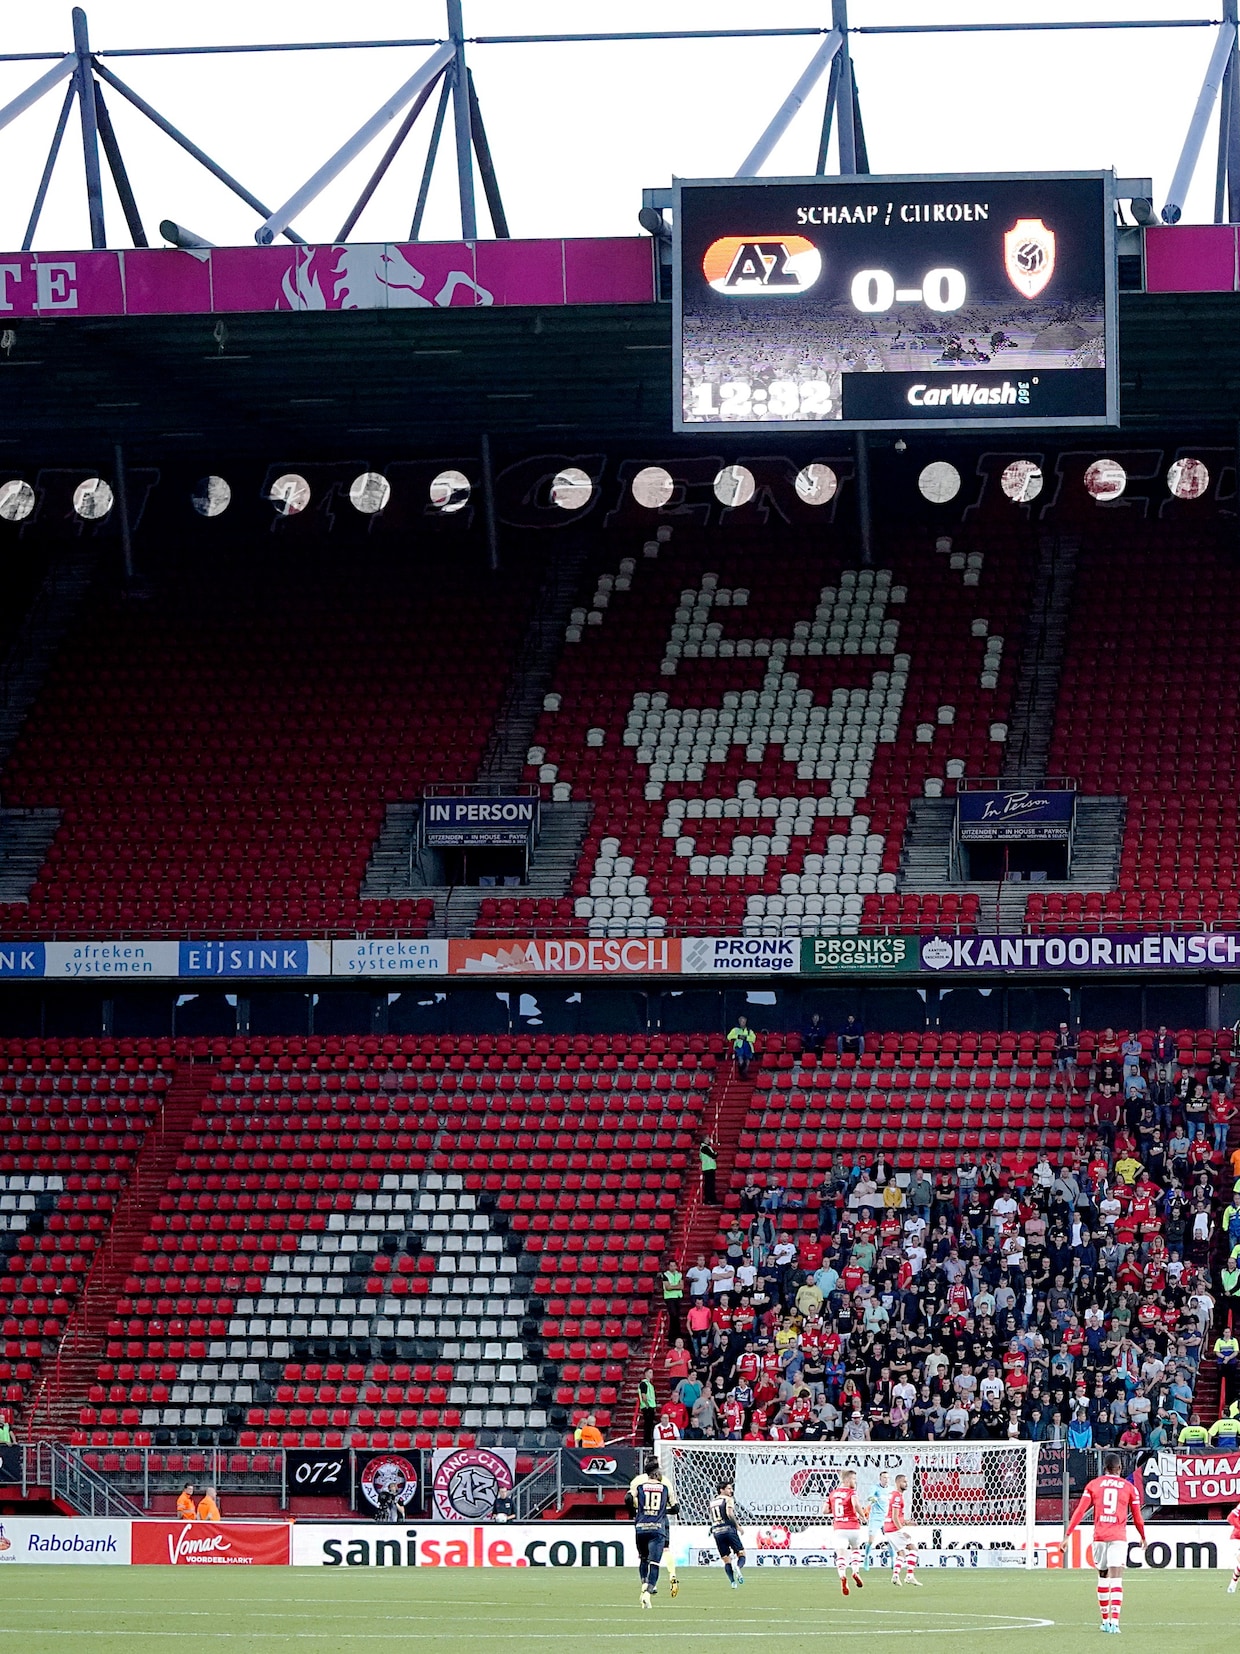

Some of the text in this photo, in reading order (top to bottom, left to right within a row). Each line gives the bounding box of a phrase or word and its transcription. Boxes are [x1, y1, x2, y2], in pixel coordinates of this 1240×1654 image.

[796, 202, 878, 225] SCHAAP
[722, 241, 802, 288] AZ
[851, 267, 967, 313] 0-0
[907, 383, 1017, 406] CarWash
[430, 803, 533, 821] IN PERSON
[981, 791, 1051, 820] In Person
[73, 944, 145, 959] afreken
[357, 941, 430, 956] afreken
[714, 939, 794, 955] PRONK
[814, 938, 906, 953] PRONK'S
[349, 956, 439, 973] systemen
[523, 940, 669, 972] ARDESCH
[713, 955, 794, 971] montage
[814, 952, 906, 965] DOGSHOP
[65, 960, 153, 976] systemen
[437, 1452, 511, 1487] PANC-CITY
[749, 1453, 903, 1469] WAARLAND
[452, 1468, 497, 1508] AZ
[1100, 1479, 1126, 1489] AFAS
[1145, 1481, 1180, 1500] ON
[643, 1491, 661, 1510] 18
[749, 1501, 820, 1515] Supporting
[834, 1497, 845, 1518] 6
[1103, 1487, 1118, 1515] 9
[28, 1533, 118, 1552] Rabobank
[322, 1527, 625, 1567] sanisale.com
[186, 1556, 254, 1565] VOORDEELMARKT
